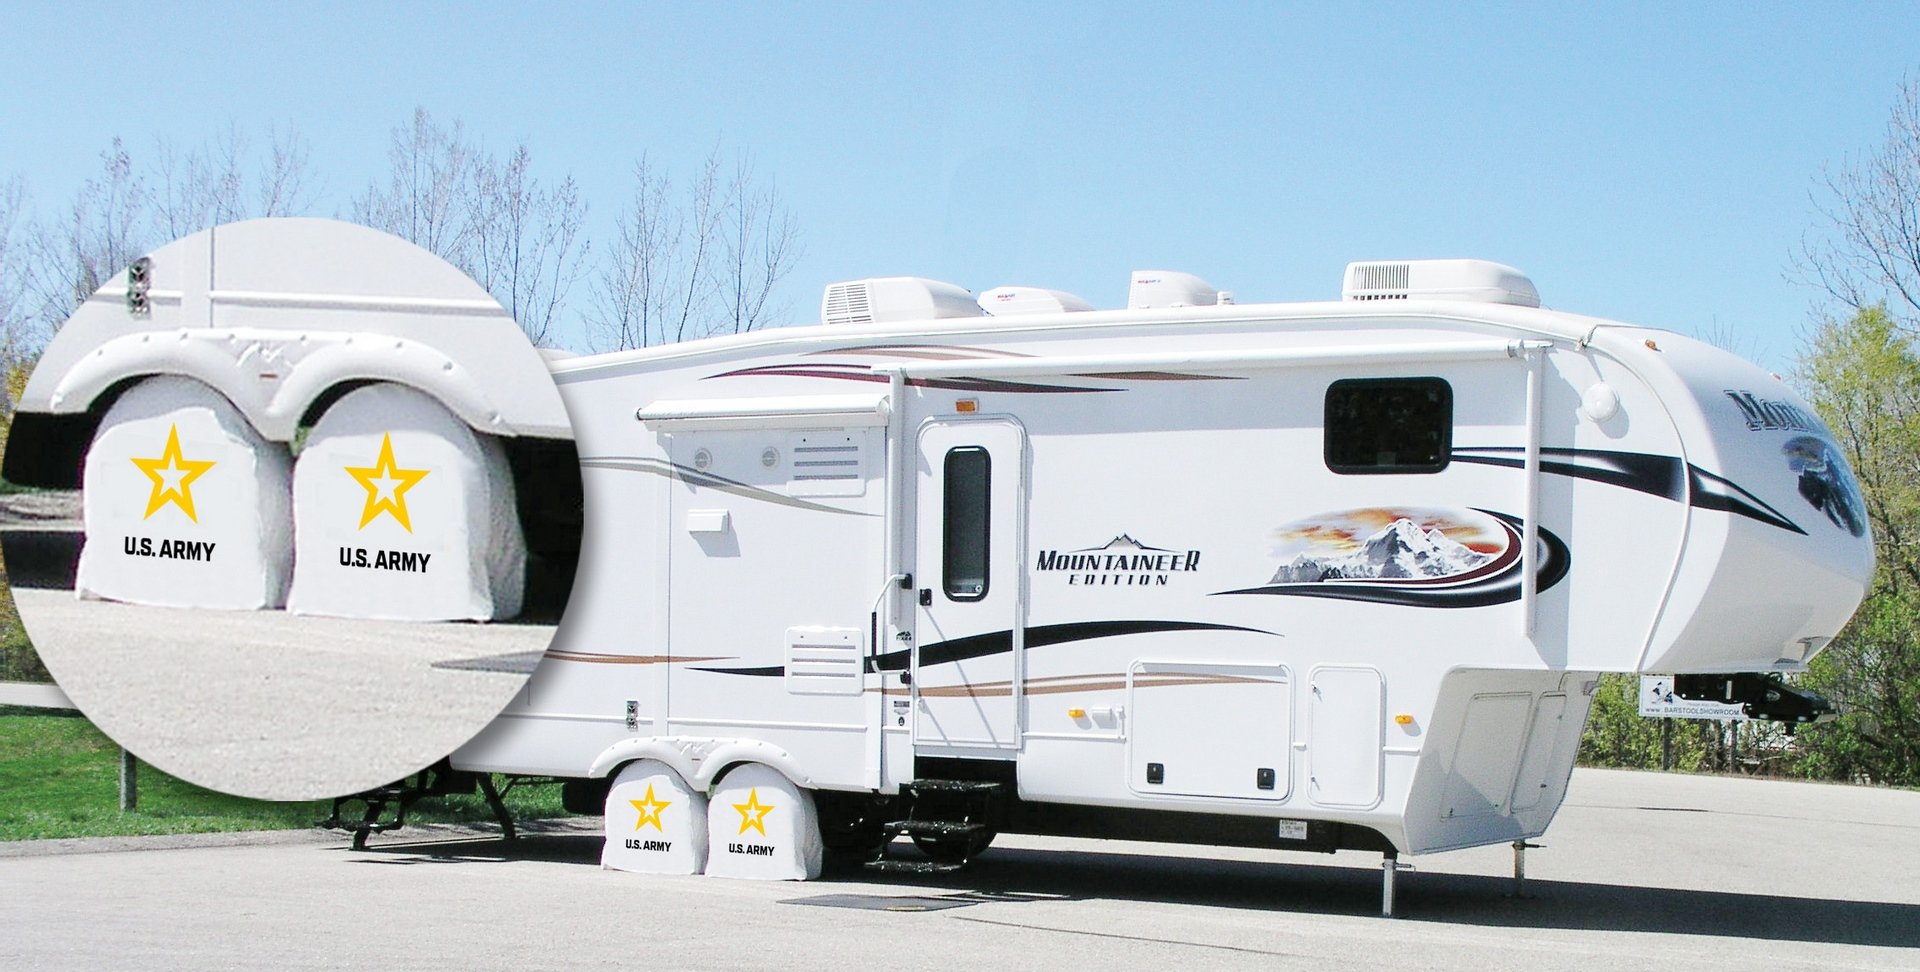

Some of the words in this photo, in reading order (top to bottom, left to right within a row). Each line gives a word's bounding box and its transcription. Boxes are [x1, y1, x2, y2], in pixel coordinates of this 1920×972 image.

[125, 536, 156, 557] U.S.
[159, 539, 216, 562] ARMY
[340, 547, 371, 568] U.S.
[374, 550, 431, 573] ARMY
[1068, 574, 1169, 586] EDITION
[625, 839, 642, 850] U.S.
[643, 840, 672, 852] ARMY
[729, 843, 745, 854] U.S.
[746, 844, 775, 856] ARMY
